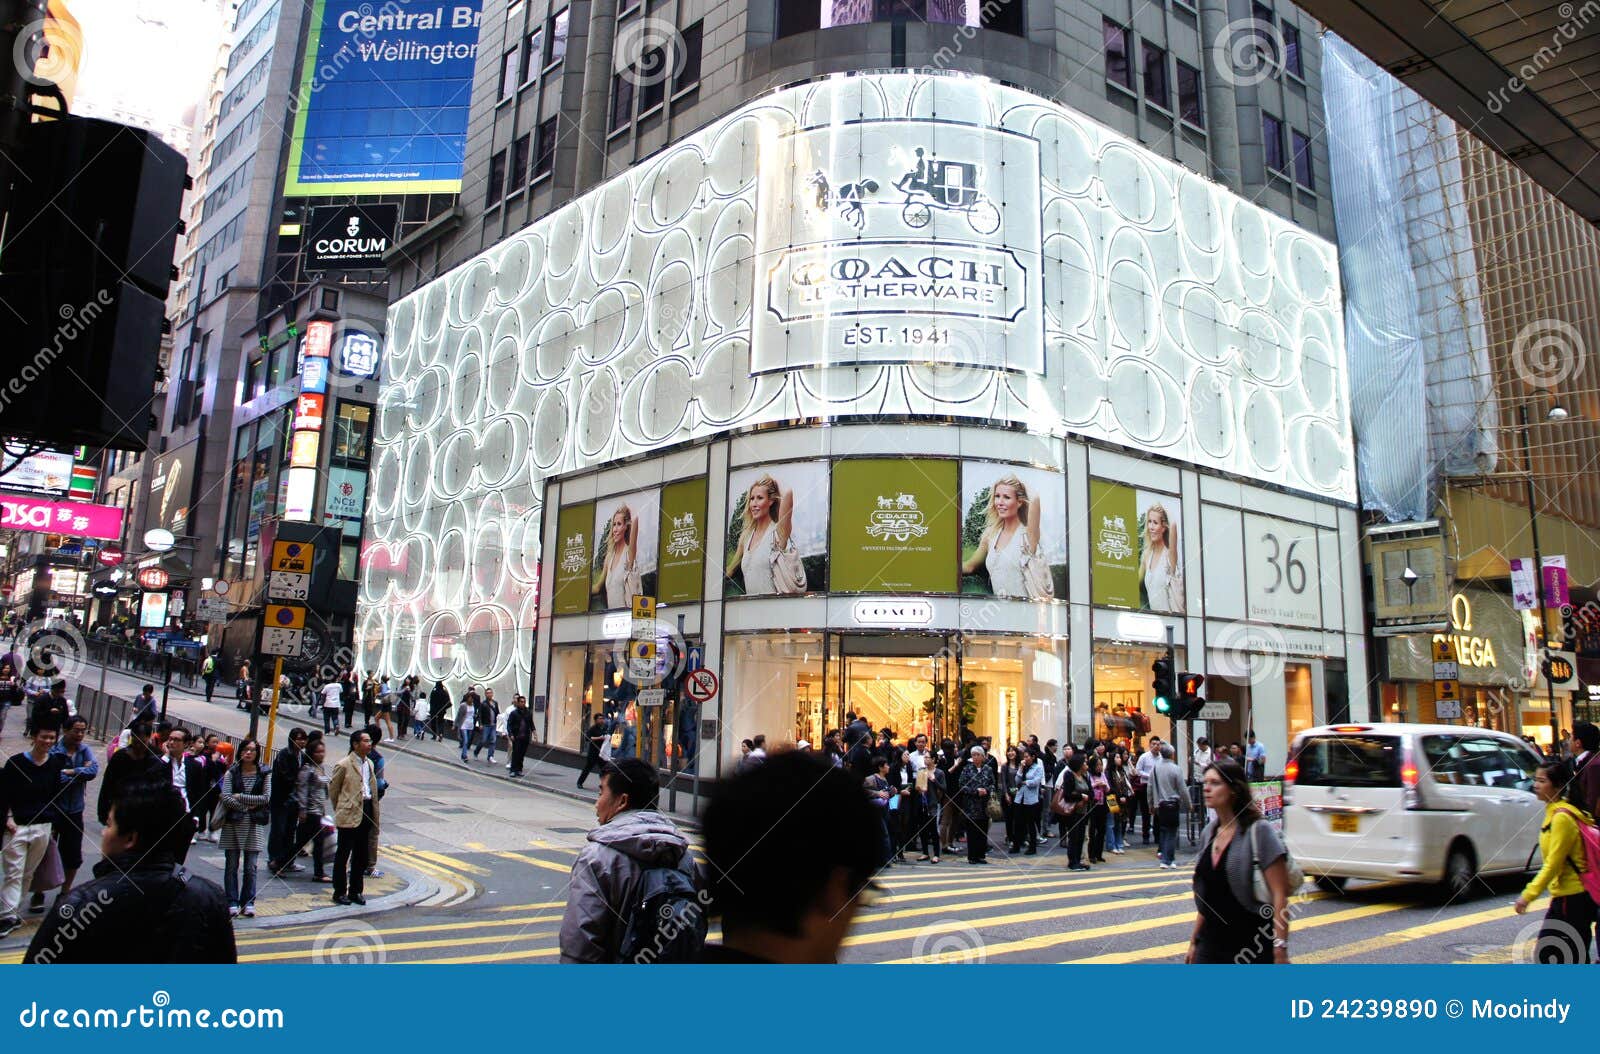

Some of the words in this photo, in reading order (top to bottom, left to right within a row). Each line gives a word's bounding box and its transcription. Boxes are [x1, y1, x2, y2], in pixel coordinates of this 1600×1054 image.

[338, 7, 443, 33] Central
[315, 238, 386, 254] CORUM
[791, 257, 1003, 286] COACH
[800, 283, 994, 303] LEATHERWARE
[844, 327, 892, 345] EST.
[902, 328, 949, 345] 1941
[881, 519, 910, 542] 70
[1261, 532, 1306, 595] 36
[296, 574, 302, 583] 7
[294, 590, 306, 599] 12
[289, 631, 296, 640] 7
[287, 645, 294, 655] 7
